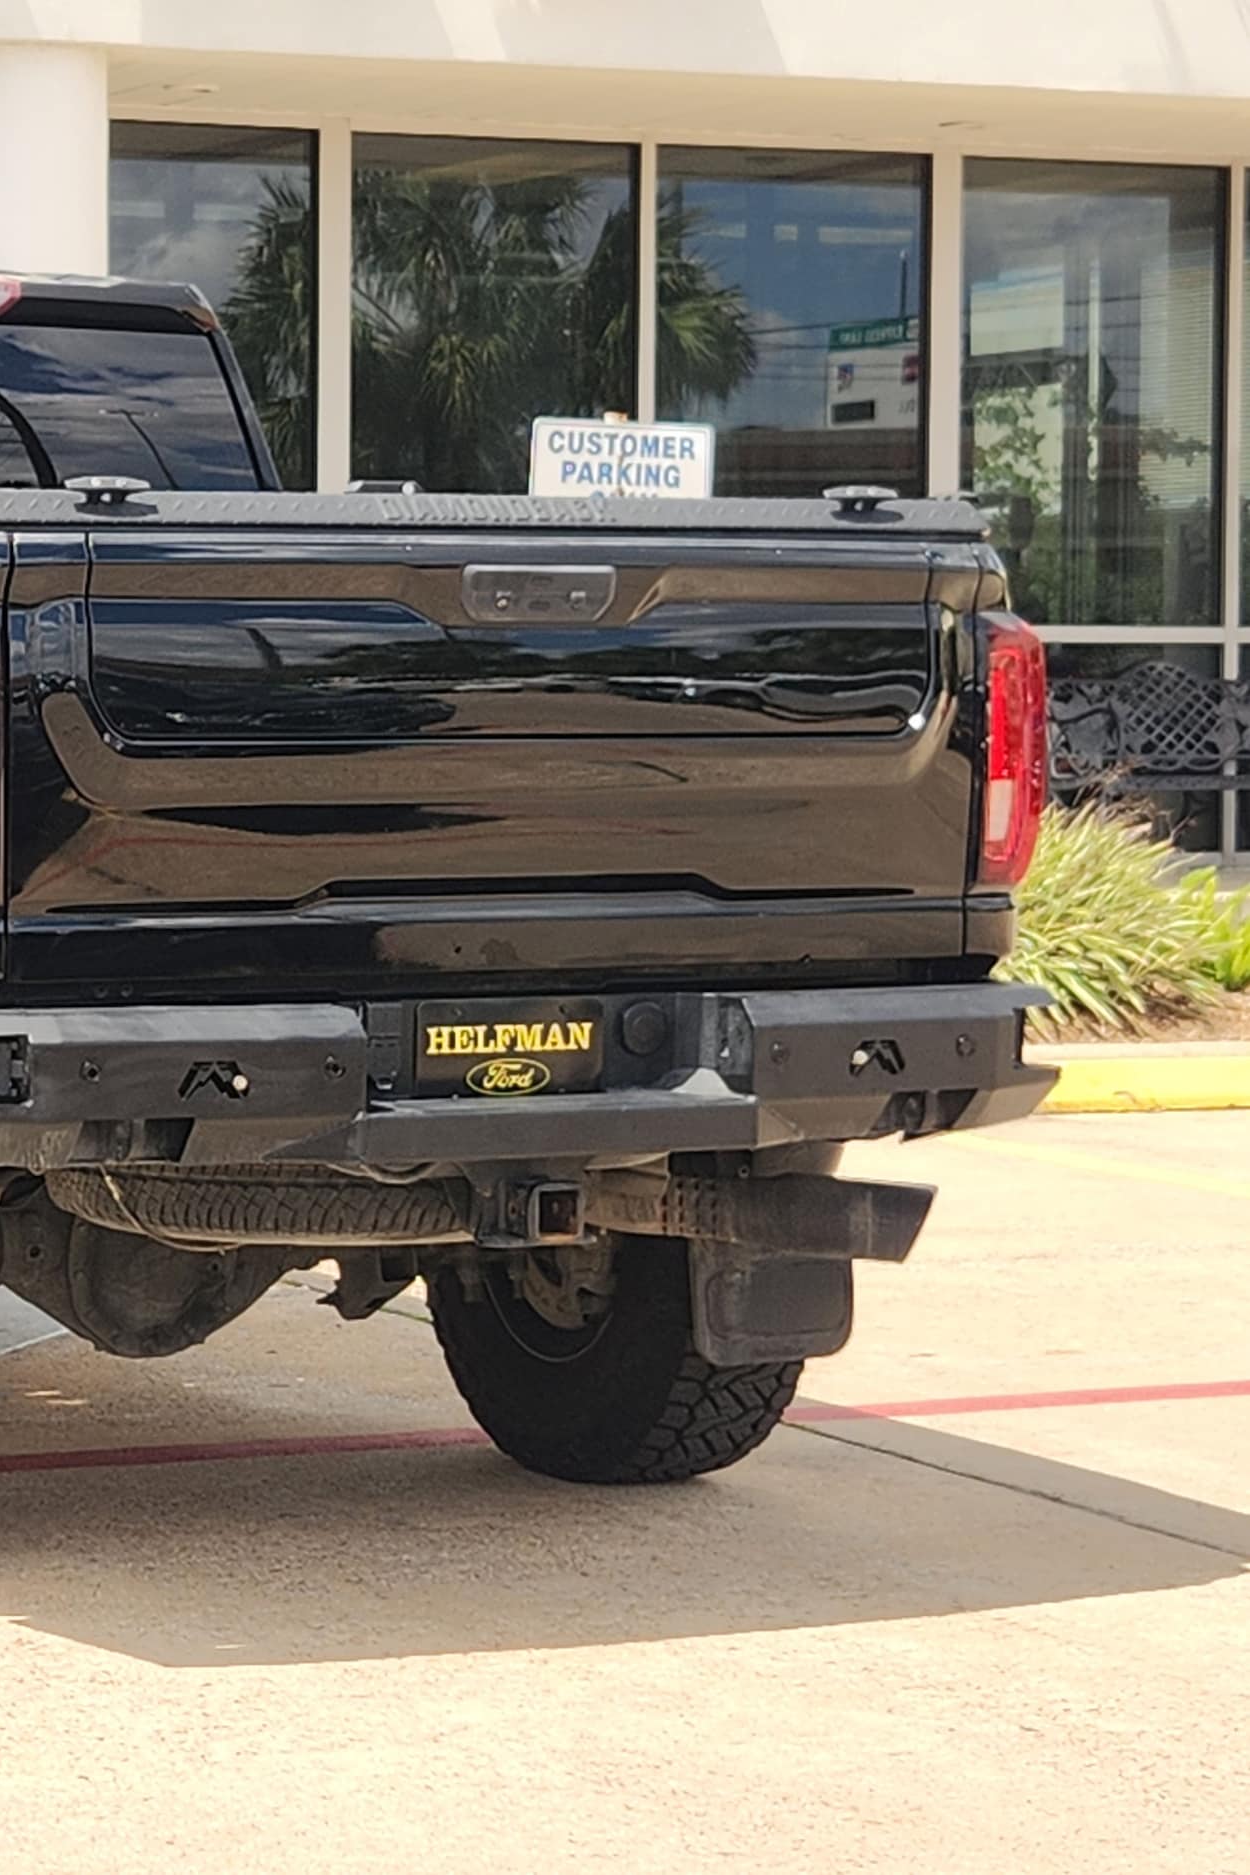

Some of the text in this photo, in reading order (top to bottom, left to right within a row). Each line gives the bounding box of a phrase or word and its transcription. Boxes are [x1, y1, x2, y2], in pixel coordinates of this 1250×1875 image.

[548, 430, 695, 460] CUSTOMER
[560, 460, 681, 489] PARKING
[425, 1021, 594, 1056] HELFMAN
[482, 1062, 536, 1090] Ford
